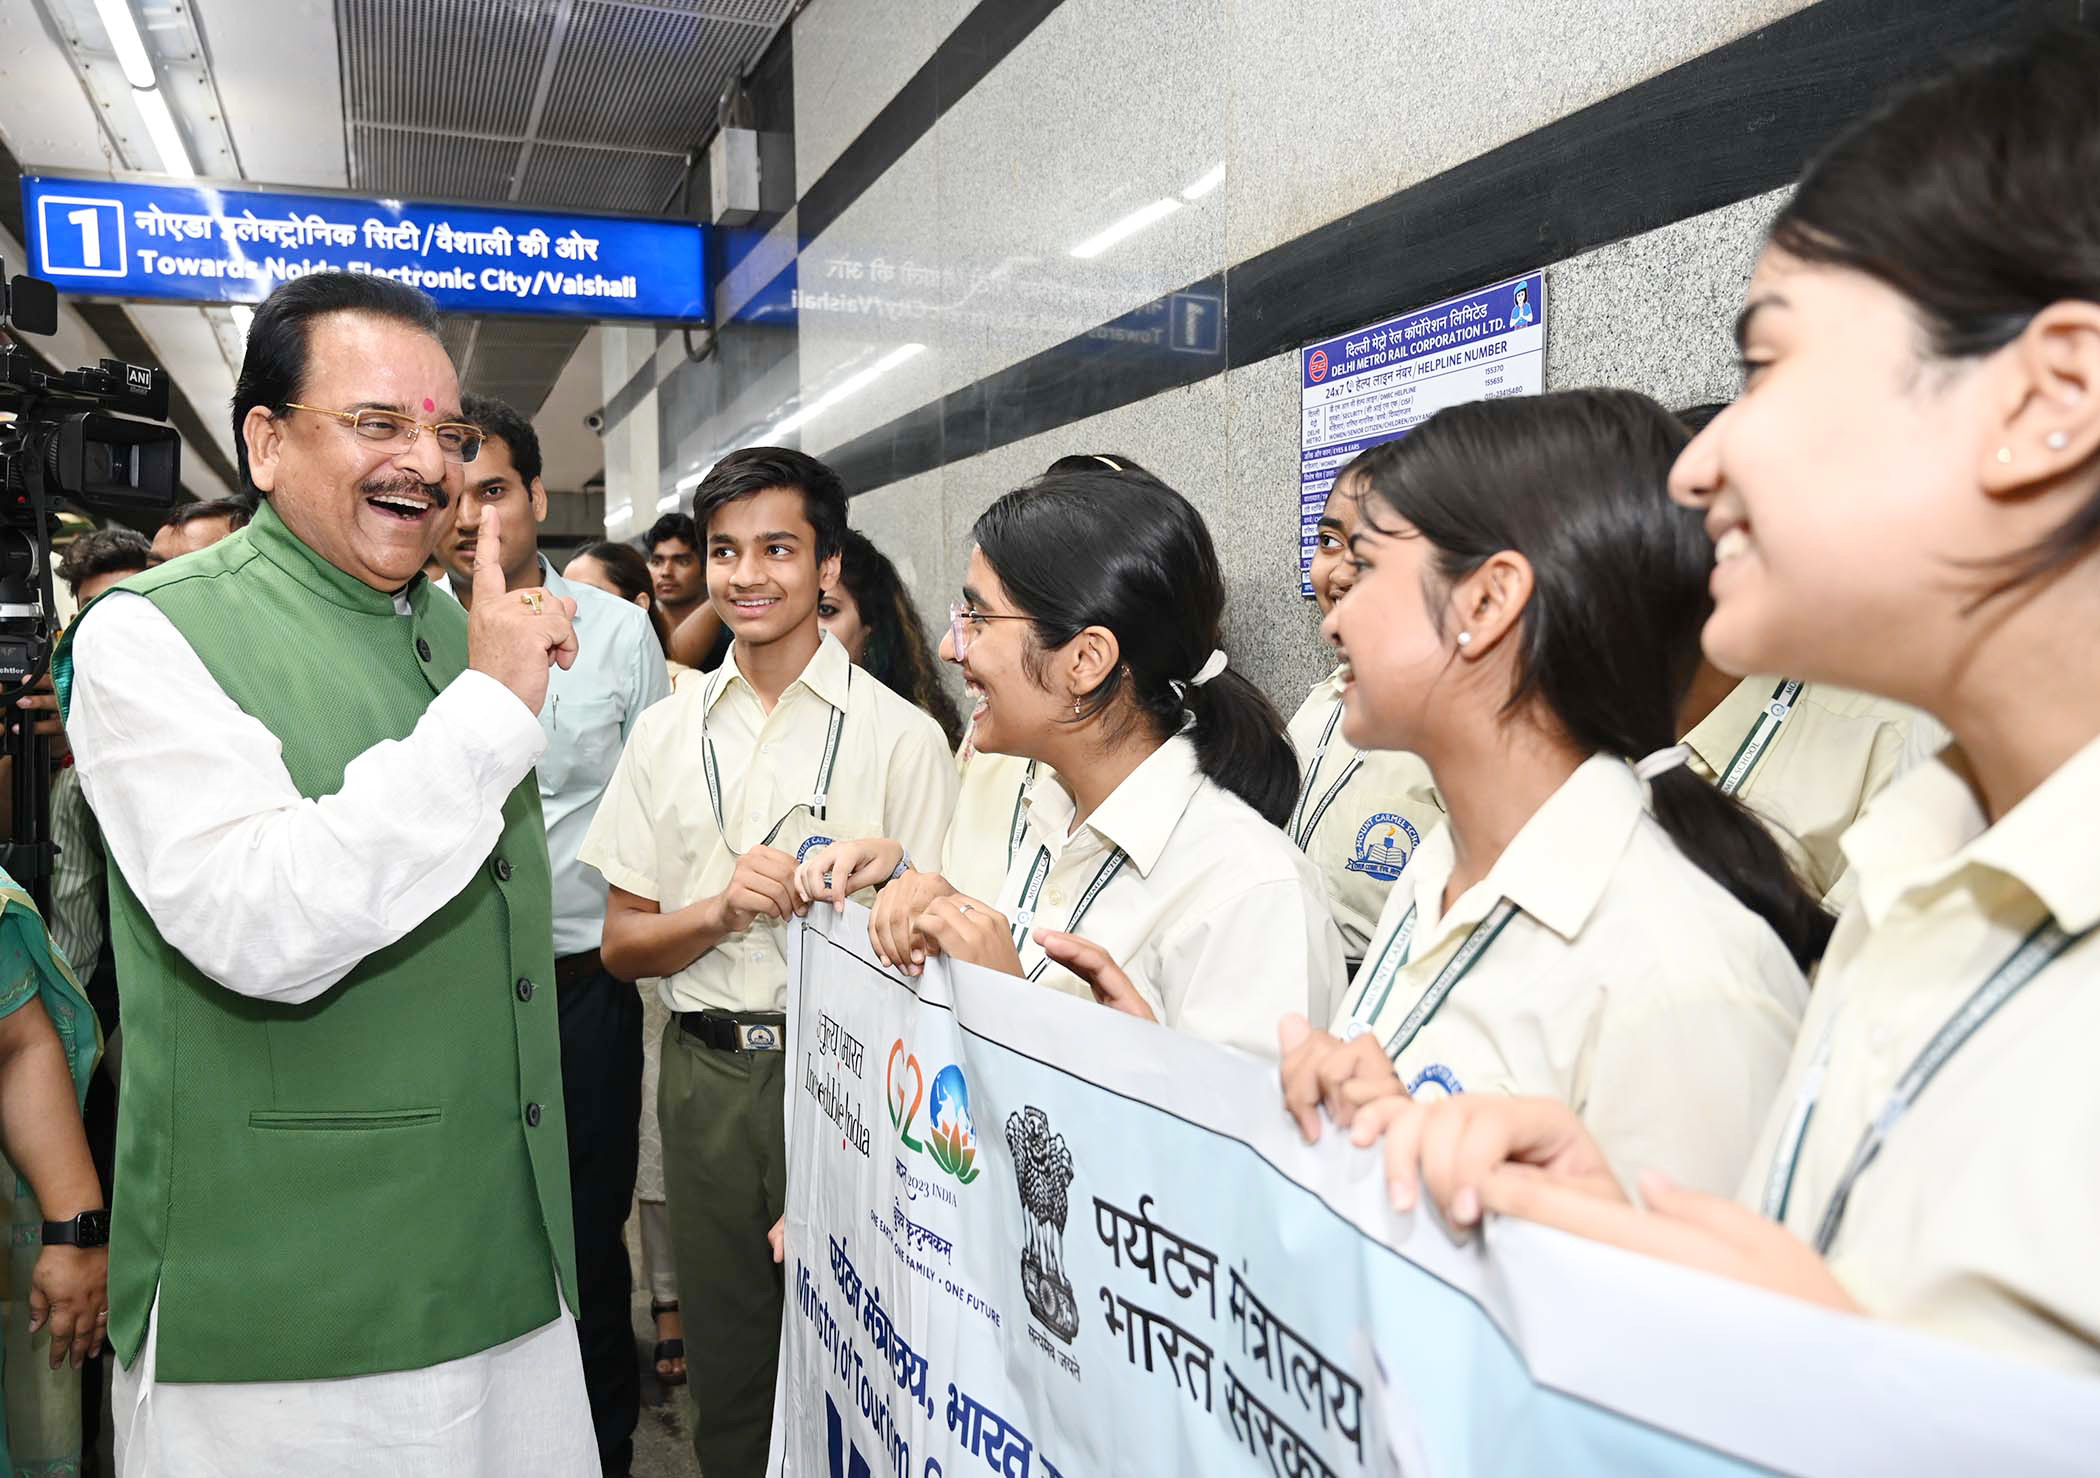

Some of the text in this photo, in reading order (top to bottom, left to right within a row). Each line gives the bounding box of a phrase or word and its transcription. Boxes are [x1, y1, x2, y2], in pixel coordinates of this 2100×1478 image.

[67, 207, 101, 268] 1
[133, 202, 214, 242] नोएडा
[516, 227, 550, 260] की
[554, 229, 600, 262] ओर
[137, 249, 258, 281] Towards
[480, 268, 637, 299] City/Vaishali
[1331, 317, 1506, 378] DELHI METRO RAIL CORPORATION LTD.
[1345, 336, 1371, 358] दिल्ली
[1372, 331, 1388, 352] मेट्रो
[1389, 328, 1402, 345] रेल
[1450, 301, 1488, 328] लिमिटेड
[129, 369, 149, 385] ANI
[1325, 384, 1344, 400] 24x7
[1464, 340, 1508, 363] NUMBER
[1735, 741, 1761, 776] SCHOOL
[1356, 814, 1419, 849] MOUNT CARMEL SCHO
[1028, 868, 1045, 900] MOUNT
[1103, 850, 1126, 877] SCHOO
[907, 1174, 930, 1198] 2023
[932, 1183, 957, 1208] INDIA
[828, 1233, 862, 1322] पर्यटन
[906, 1255, 936, 1283] FAMILY
[945, 1279, 964, 1301] ONE
[967, 1293, 1001, 1328] FUTURE
[796, 1257, 840, 1375] Ministry
[840, 1337, 852, 1390] of
[1092, 1194, 1365, 1465] पर्यटन मंत्रालय
[1099, 1286, 1342, 1478] भारत सरक
